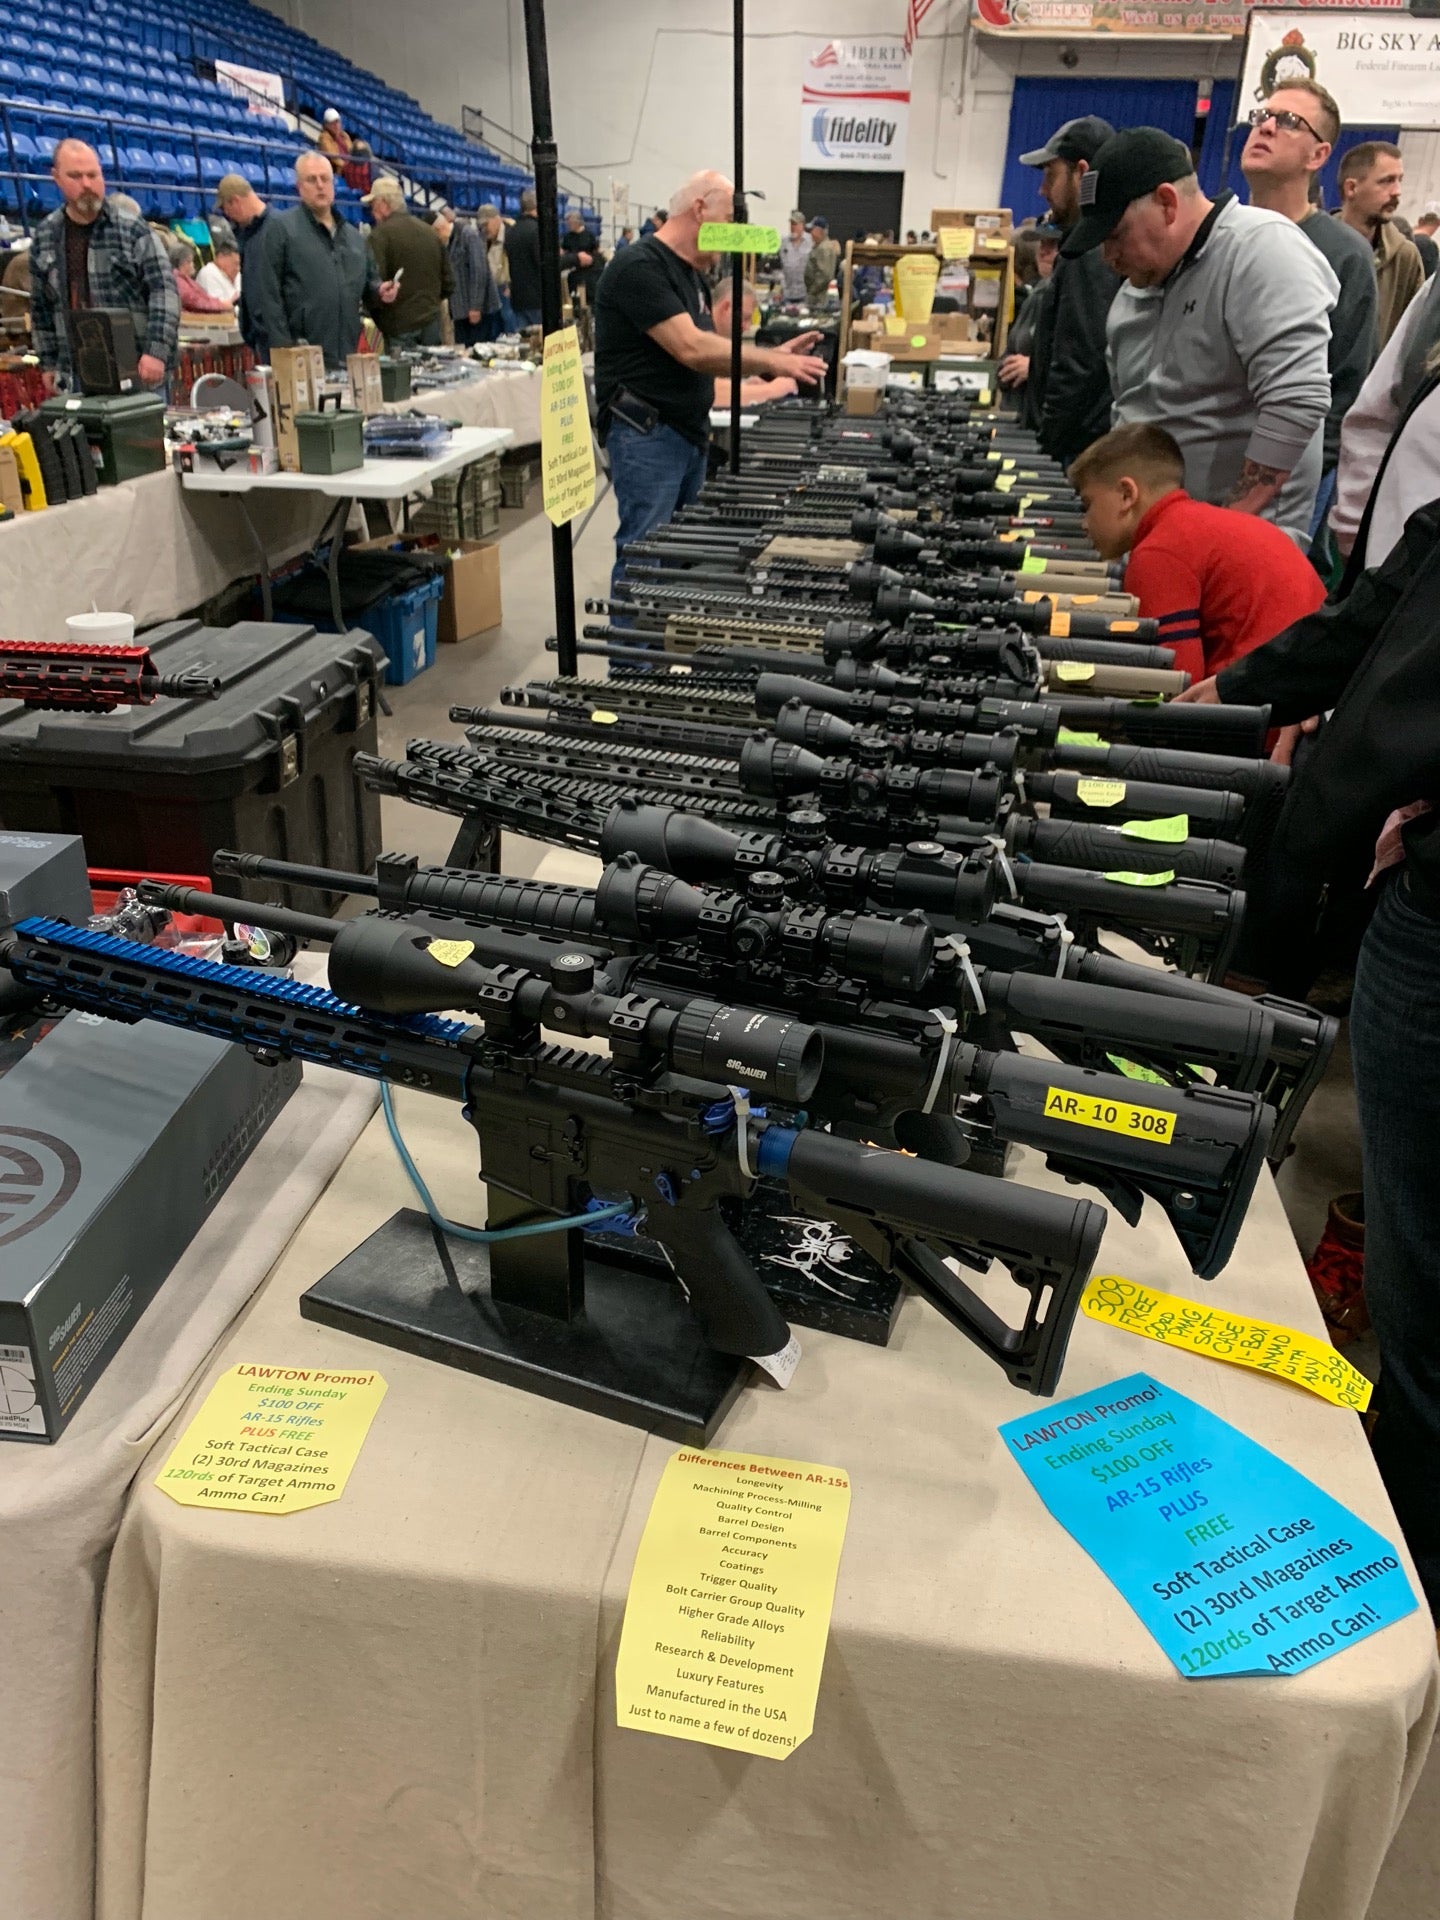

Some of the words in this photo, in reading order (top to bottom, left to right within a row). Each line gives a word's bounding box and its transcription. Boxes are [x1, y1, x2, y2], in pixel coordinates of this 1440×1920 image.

[1336, 32, 1374, 50] BIG
[1379, 33, 1422, 51] SKY
[829, 116, 897, 147] fidelity
[738, 1066, 768, 1080] SAUER
[1048, 1095, 1085, 1116] AR-
[1092, 1104, 1117, 1123] 10
[1128, 1112, 1167, 1135] 308
[1088, 1278, 1136, 1316] 308
[1119, 1290, 1158, 1328] FREE
[1194, 1312, 1224, 1344] SOFT
[1213, 1322, 1244, 1354] CASE
[237, 1365, 311, 1382] LAWTON
[314, 1372, 374, 1386] Promo!
[1282, 1350, 1306, 1375] WITH
[1301, 1358, 1328, 1385] ANY
[1322, 1356, 1348, 1388] 308
[248, 1383, 294, 1397] Ending
[297, 1387, 347, 1400] Sunday
[258, 1398, 293, 1410] $100
[296, 1401, 324, 1412] OFF
[1338, 1370, 1367, 1412] RIFLE
[240, 1412, 283, 1423] AR-15
[286, 1415, 324, 1427] Rifles
[1011, 1411, 1096, 1452] LAWTON
[1097, 1384, 1163, 1422] Promo!
[205, 1439, 235, 1450] Soft
[239, 1442, 291, 1455] Tactical
[295, 1448, 329, 1458] Case
[240, 1427, 276, 1438] PLUS
[279, 1430, 315, 1441] FREE
[1044, 1434, 1111, 1471] Ending
[1113, 1408, 1178, 1445] Sunday
[192, 1454, 213, 1466] (2)
[216, 1456, 251, 1468] 30rd
[252, 1461, 329, 1475] Magazines
[678, 1453, 746, 1471] Differences
[749, 1464, 803, 1481] Between
[806, 1473, 848, 1488] AR-15s
[1090, 1452, 1141, 1484] $100
[1141, 1439, 1175, 1465] OFF
[164, 1468, 214, 1481] 120rds
[218, 1472, 234, 1483] of
[238, 1474, 283, 1489] Target
[287, 1479, 336, 1491] Ammo
[736, 1477, 784, 1492] Longevity
[1106, 1473, 1162, 1513] AR-15
[1163, 1456, 1213, 1488] Rifles
[197, 1488, 247, 1501] Ammo
[252, 1492, 286, 1504] Can!
[692, 1483, 745, 1499] Machining
[747, 1492, 822, 1512] Process-Milling
[716, 1501, 753, 1513] Quality
[755, 1506, 792, 1520] Control
[1158, 1490, 1209, 1523] PLUS
[699, 1527, 730, 1538] Barrel
[732, 1532, 797, 1550] Components
[718, 1515, 748, 1527] Barrel
[751, 1520, 785, 1533] Design
[1184, 1514, 1234, 1547] FREE
[722, 1545, 768, 1560] Accuracy
[1152, 1565, 1199, 1601] Soft
[1195, 1534, 1271, 1580] Tactical
[1267, 1517, 1315, 1546] Case
[719, 1560, 764, 1575] Coatings
[700, 1572, 736, 1586] Trigger
[739, 1579, 778, 1594] Quality
[1173, 1603, 1210, 1634] (2)
[1207, 1581, 1257, 1617] 30rd
[1254, 1536, 1354, 1592] Magazines
[666, 1584, 688, 1596] Bolt
[690, 1588, 727, 1602] Carrier
[729, 1595, 763, 1610] Group
[765, 1601, 805, 1618] Quality
[1179, 1628, 1252, 1674] 120rds
[1250, 1611, 1276, 1636] of
[1273, 1584, 1339, 1625] Target
[1334, 1554, 1399, 1593] Ammo
[678, 1606, 714, 1620] Higher
[717, 1612, 750, 1626] Grade
[752, 1618, 785, 1633] Alloys
[701, 1629, 755, 1650] Reliability
[1266, 1633, 1335, 1673] Ammo
[1331, 1603, 1382, 1637] Can!
[655, 1642, 703, 1659] Research
[707, 1651, 716, 1662] &
[720, 1654, 794, 1677] Development
[676, 1668, 713, 1686] Luxury
[716, 1675, 764, 1694] Features
[646, 1684, 726, 1709] Manufactured
[729, 1699, 739, 1711] in
[742, 1702, 760, 1716] the
[764, 1707, 787, 1722] USA
[629, 1704, 651, 1717] Just
[654, 1709, 666, 1721] to
[669, 1714, 701, 1728] name
[704, 1721, 710, 1730] a
[713, 1720, 735, 1735] few
[737, 1726, 750, 1738] of
[752, 1729, 797, 1748] dozens!
